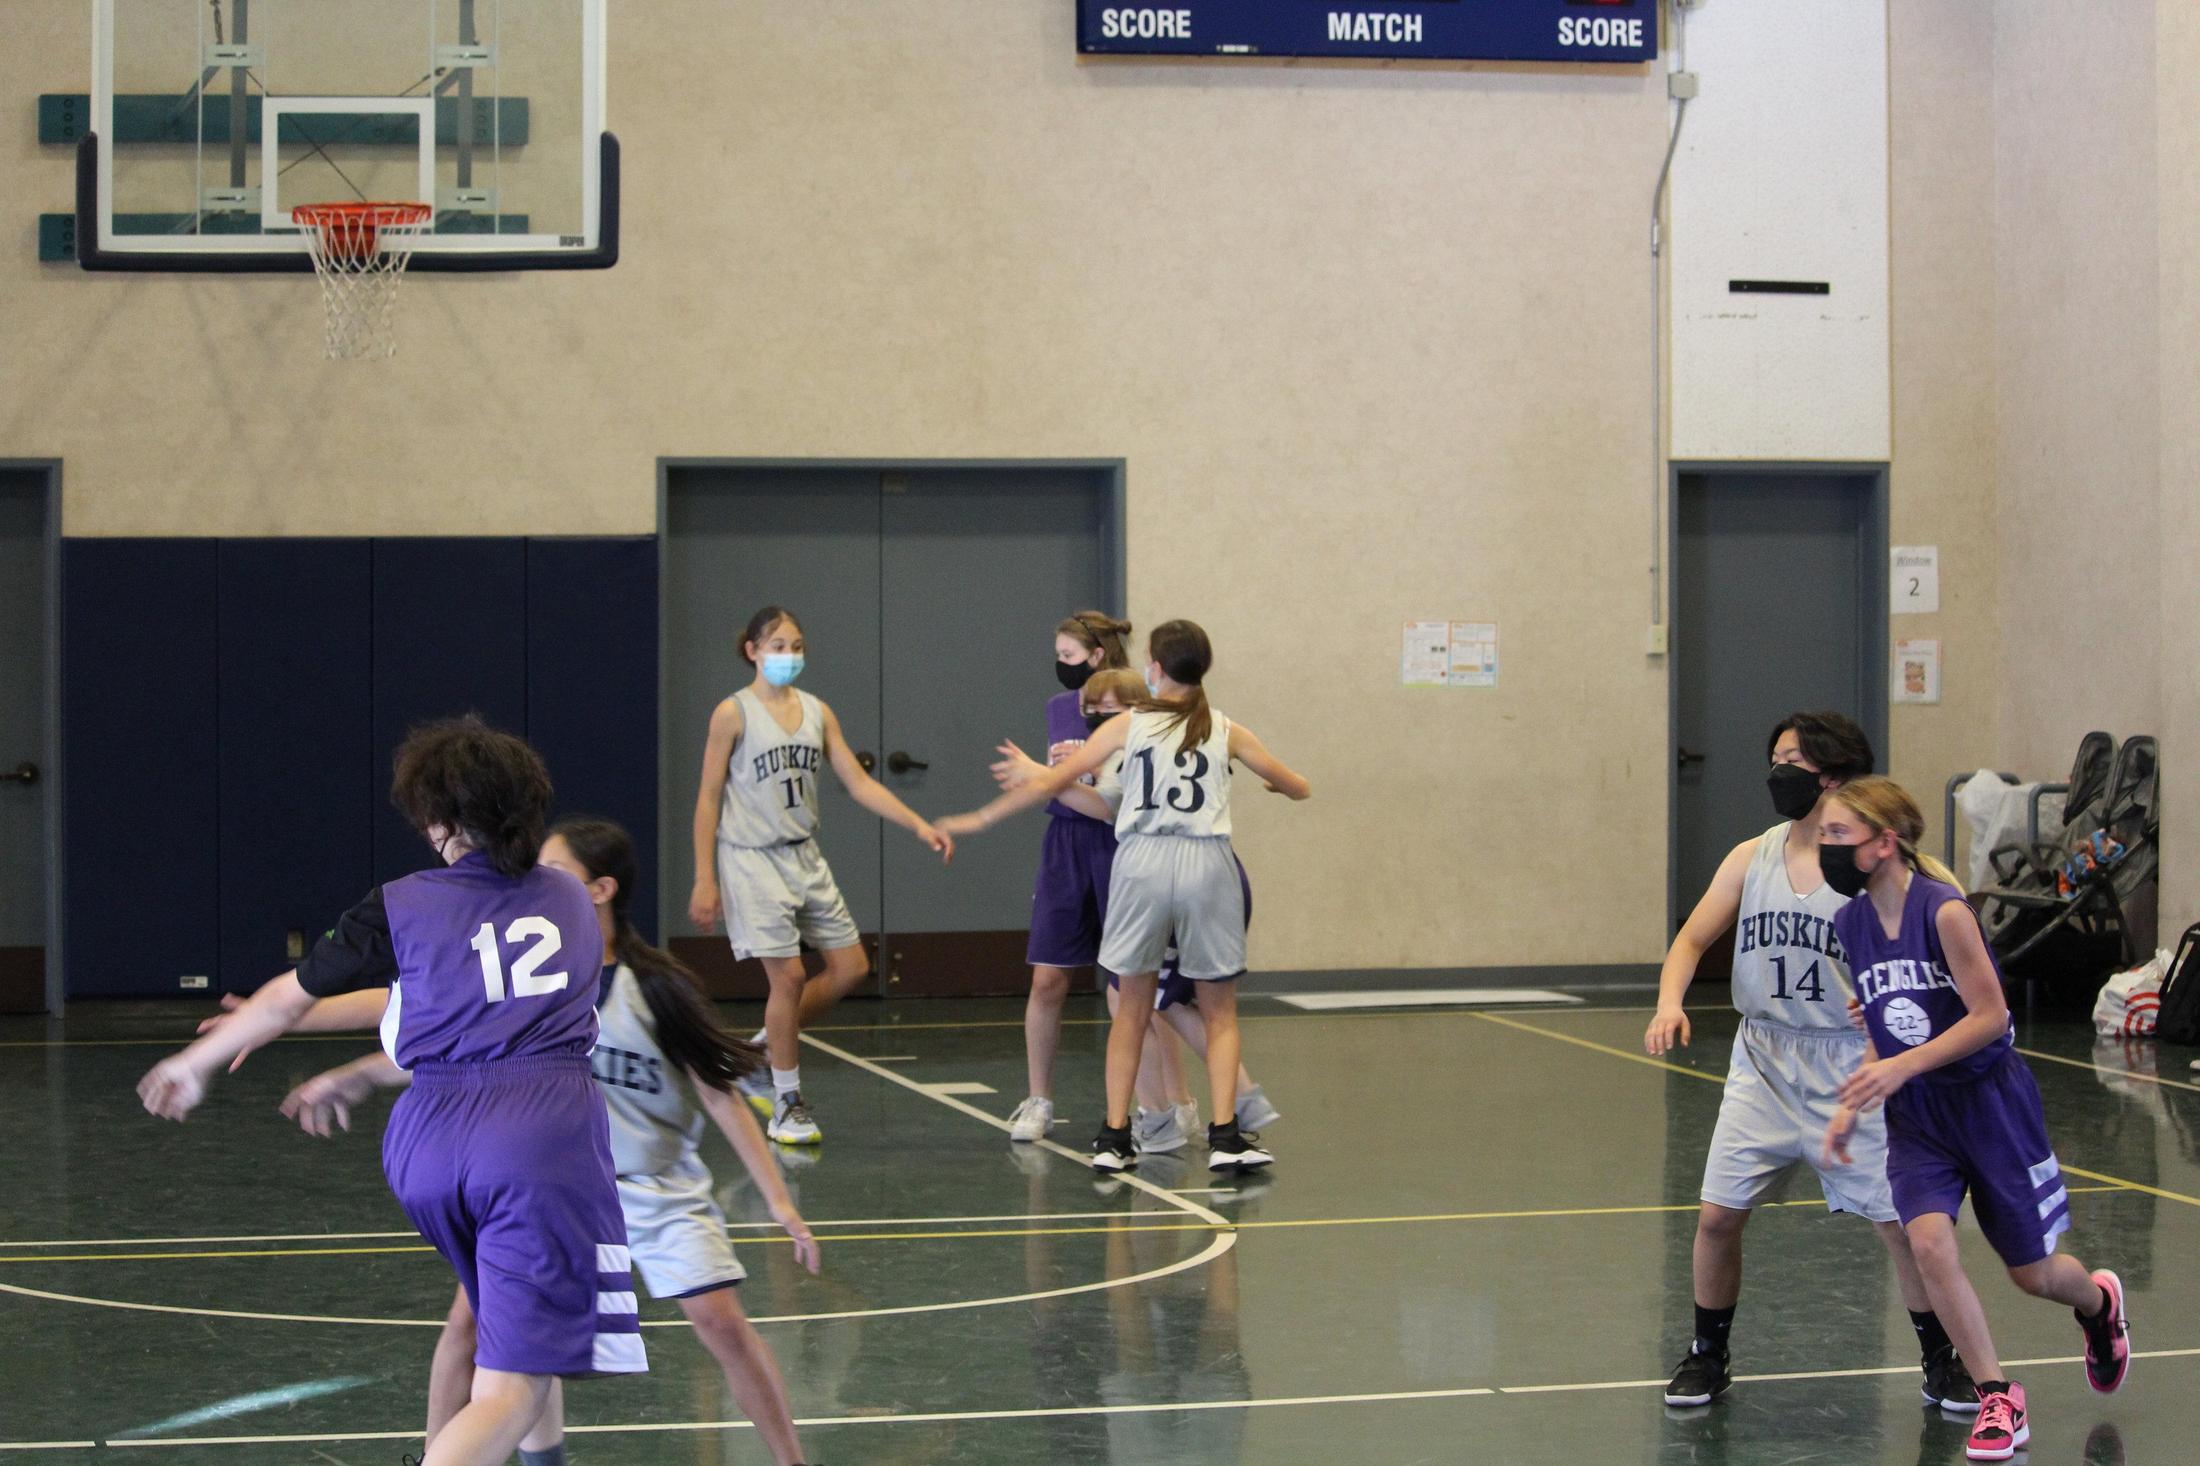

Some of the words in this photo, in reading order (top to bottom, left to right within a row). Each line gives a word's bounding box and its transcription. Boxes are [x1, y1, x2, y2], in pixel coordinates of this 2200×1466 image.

[1101, 9, 1191, 38] SCORE
[1327, 13, 1422, 42] MATCH
[1558, 17, 1643, 47] SCORE
[1909, 576, 1920, 597] 2
[1134, 746, 1209, 813] 13
[1741, 911, 1849, 962] HUSKIE
[470, 916, 568, 1003] 12
[1769, 956, 1825, 1002] 14
